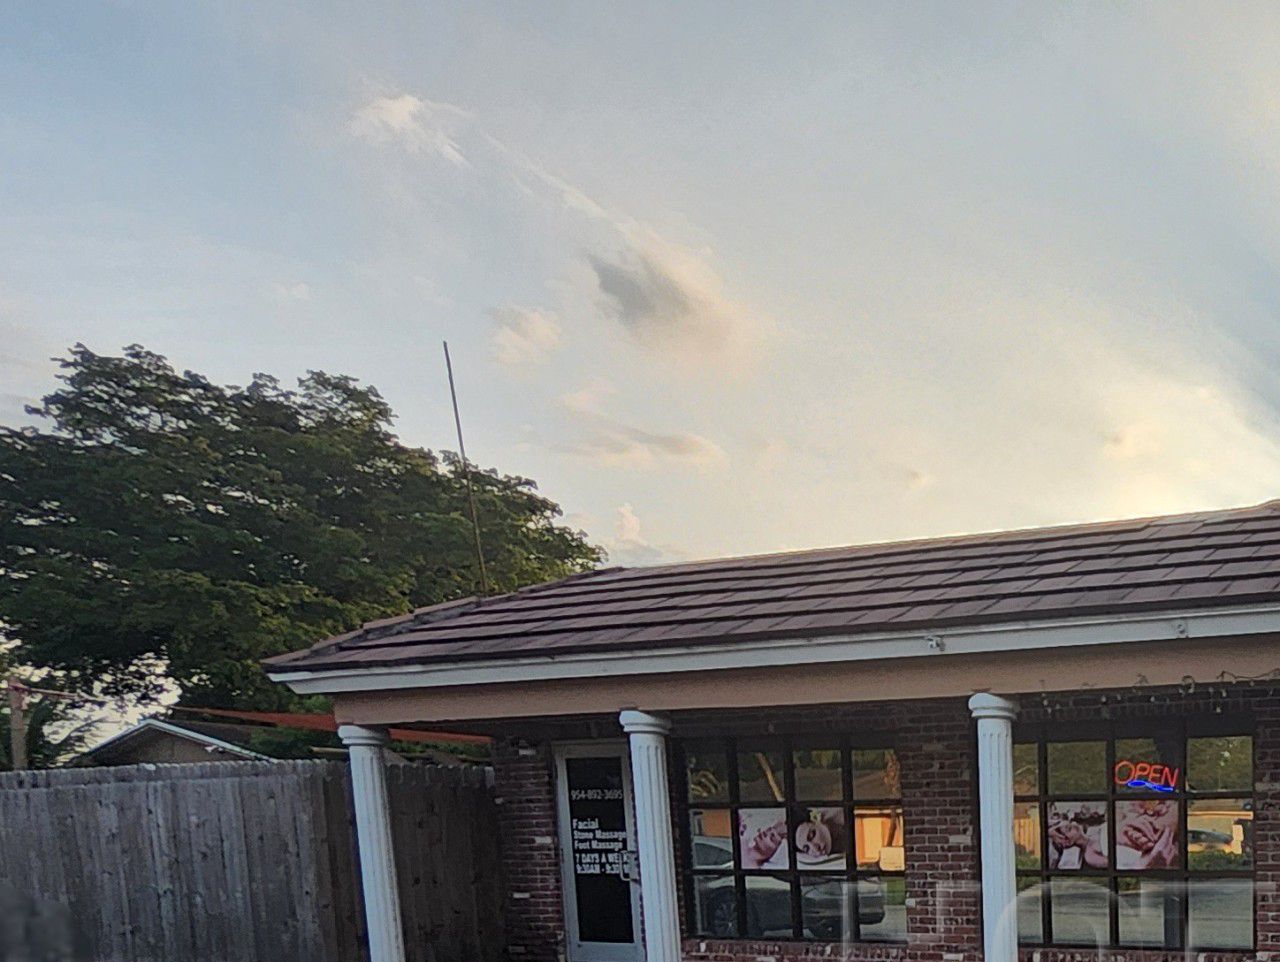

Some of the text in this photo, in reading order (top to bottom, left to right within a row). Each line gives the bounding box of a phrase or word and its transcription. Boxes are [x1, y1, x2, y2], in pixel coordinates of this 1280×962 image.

[1114, 760, 1180, 787] OPEN
[572, 818, 599, 829] Facial
[574, 840, 623, 851] Foot Massage
[575, 852, 629, 864] 7 DAYS A WEK
